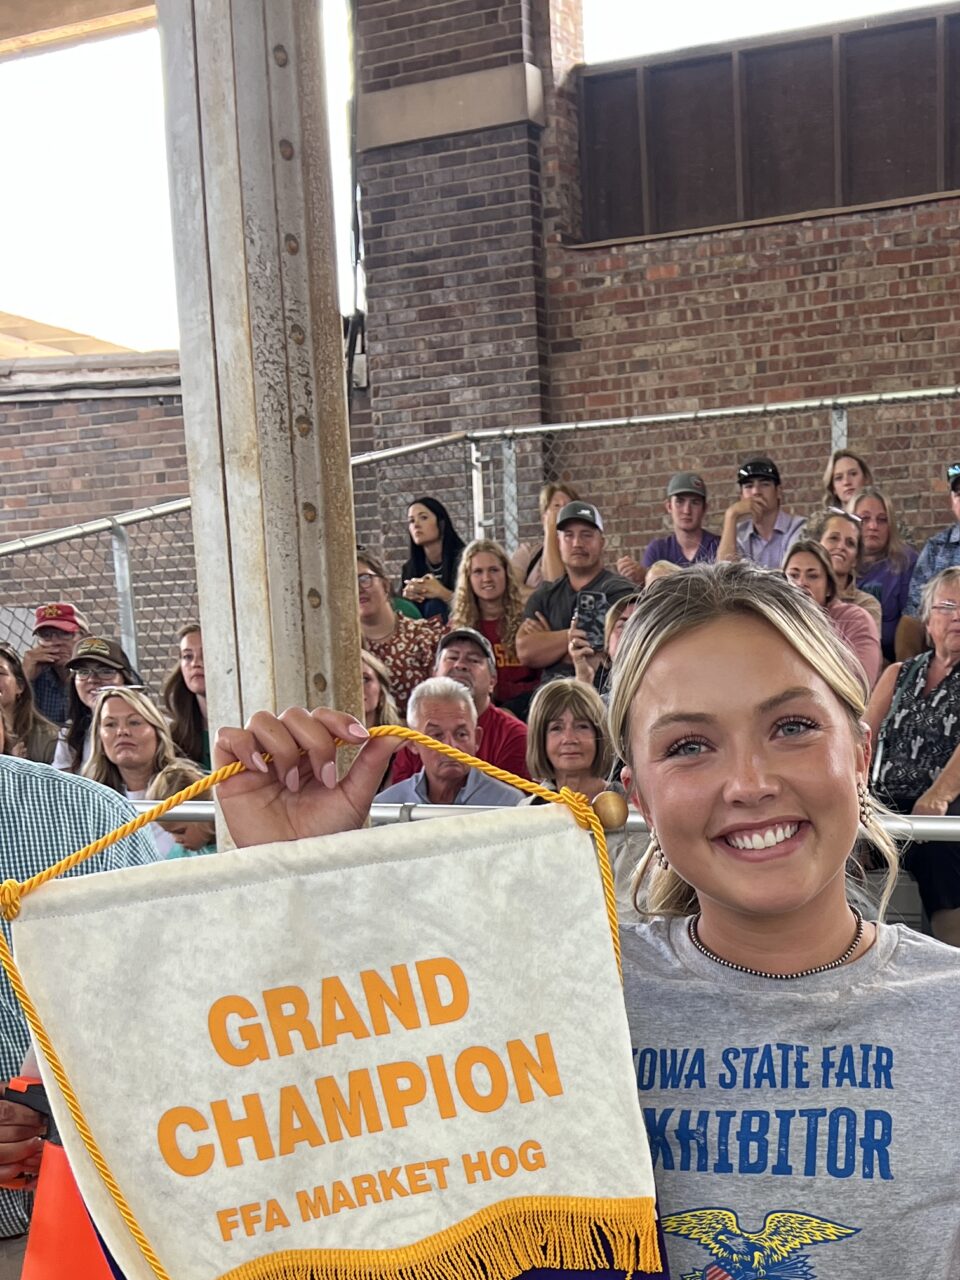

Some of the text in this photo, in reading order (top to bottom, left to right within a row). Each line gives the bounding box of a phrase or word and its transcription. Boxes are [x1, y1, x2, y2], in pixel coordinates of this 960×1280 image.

[207, 956, 470, 1067] GRAND
[157, 1032, 564, 1177] CHAMPION
[632, 1043, 894, 1090] OWA STATE FAIR
[216, 1139, 547, 1242] FFA MARKET HOG
[643, 1107, 894, 1180] XHIBITOR
